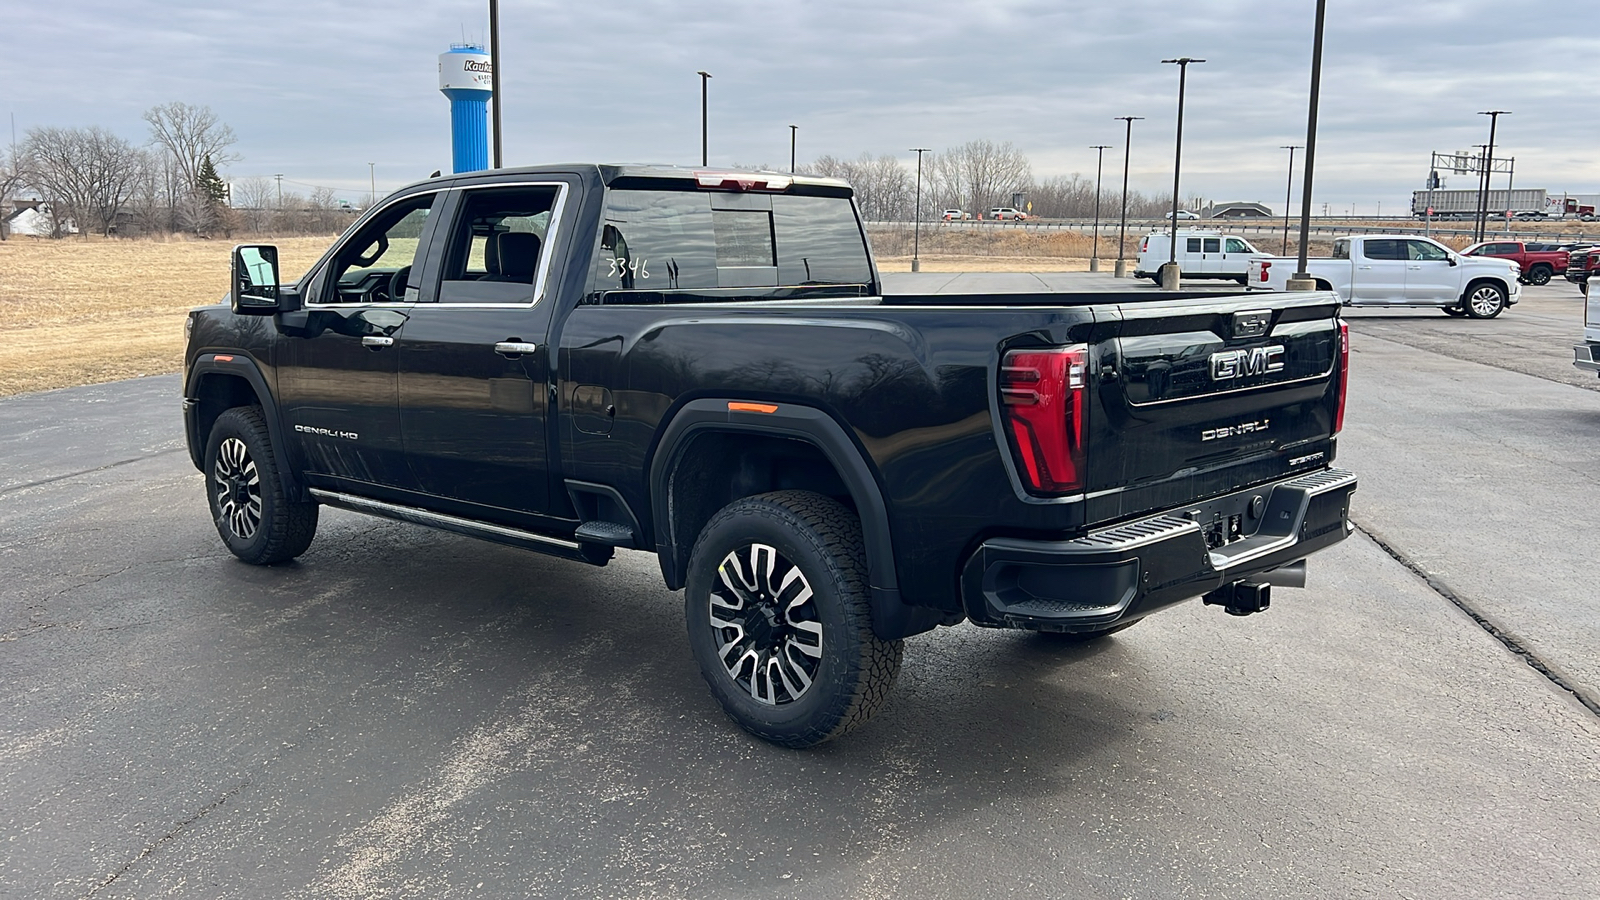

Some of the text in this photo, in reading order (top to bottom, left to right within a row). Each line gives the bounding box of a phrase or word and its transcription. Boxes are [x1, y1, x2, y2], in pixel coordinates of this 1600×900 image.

[606, 257, 650, 279] 3346
[1208, 345, 1285, 381] GMC
[294, 424, 359, 440] DENALI HD
[1202, 419, 1270, 441] DENALI
